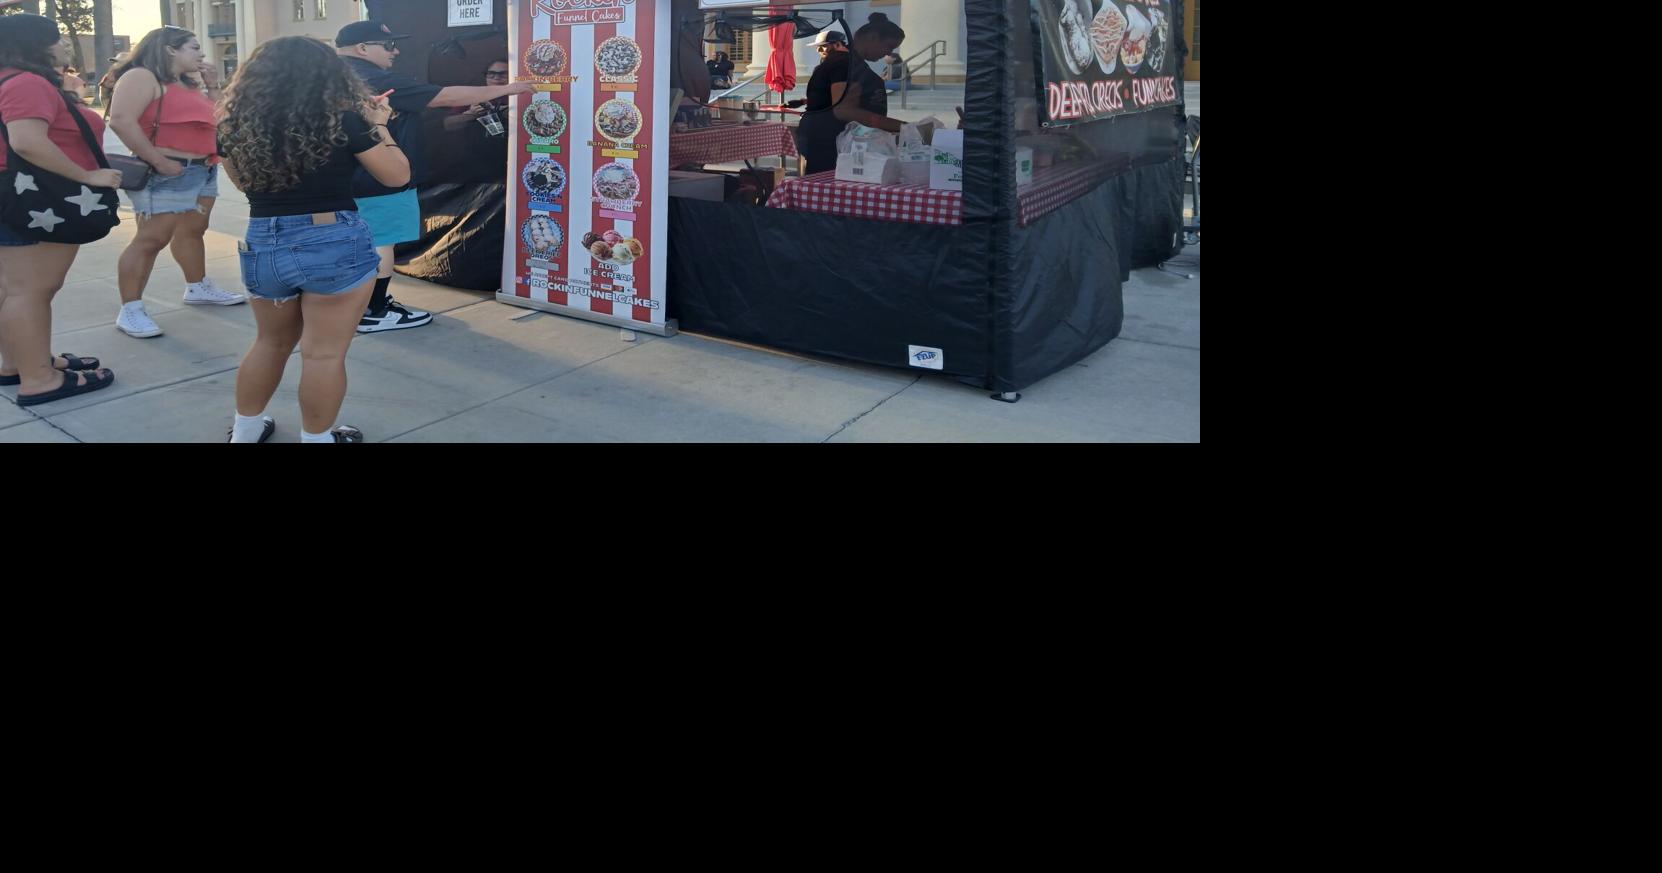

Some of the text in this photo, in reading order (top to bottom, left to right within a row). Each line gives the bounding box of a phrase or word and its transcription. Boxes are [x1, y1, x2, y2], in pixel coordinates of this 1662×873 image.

[460, 7, 480, 18] HERE
[557, 9, 621, 24] Funnel Cakes
[599, 75, 638, 83] CLASSIC
[587, 140, 648, 150] BANANA CREAM
[598, 263, 619, 271] ADD
[584, 268, 635, 282] ICE CREAM
[532, 278, 660, 310] ROCKINFUNNELCAKES
